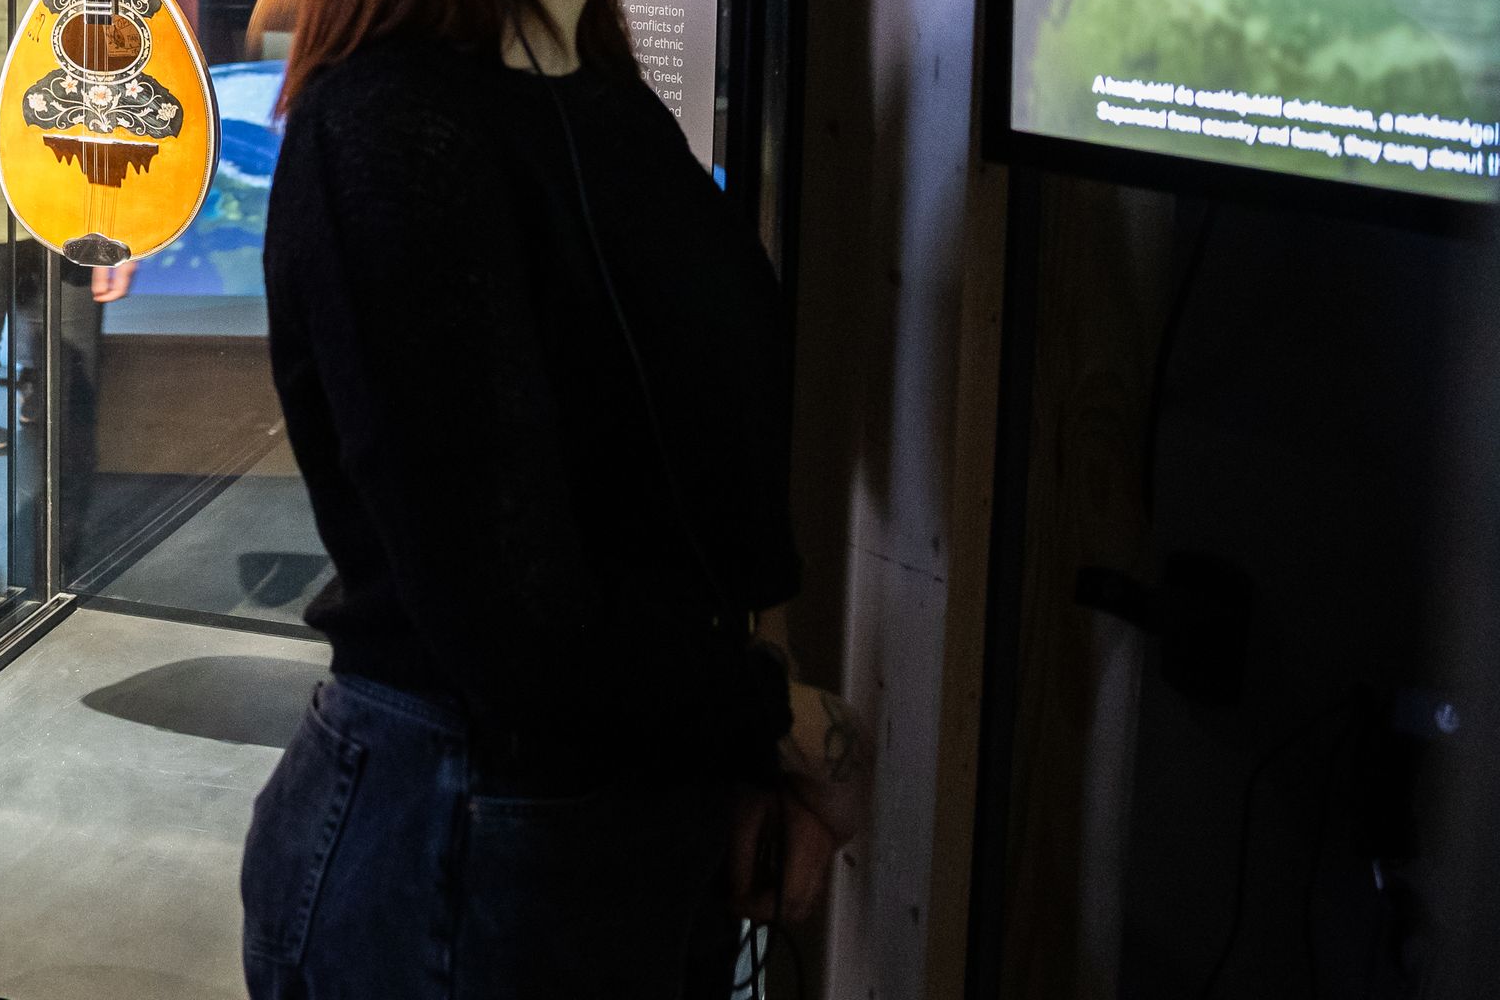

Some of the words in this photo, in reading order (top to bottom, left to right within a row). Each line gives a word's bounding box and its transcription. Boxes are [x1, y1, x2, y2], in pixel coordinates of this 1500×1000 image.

[630, 3, 685, 16] emigration
[631, 20, 672, 32] conflicts
[674, 23, 684, 33] of
[643, 36, 653, 47] of
[654, 38, 684, 50] ethnic
[635, 52, 669, 67] ttempt
[673, 56, 683, 67] to
[641, 69, 651, 80] of
[653, 70, 683, 85] Greek
[664, 89, 682, 100] and
